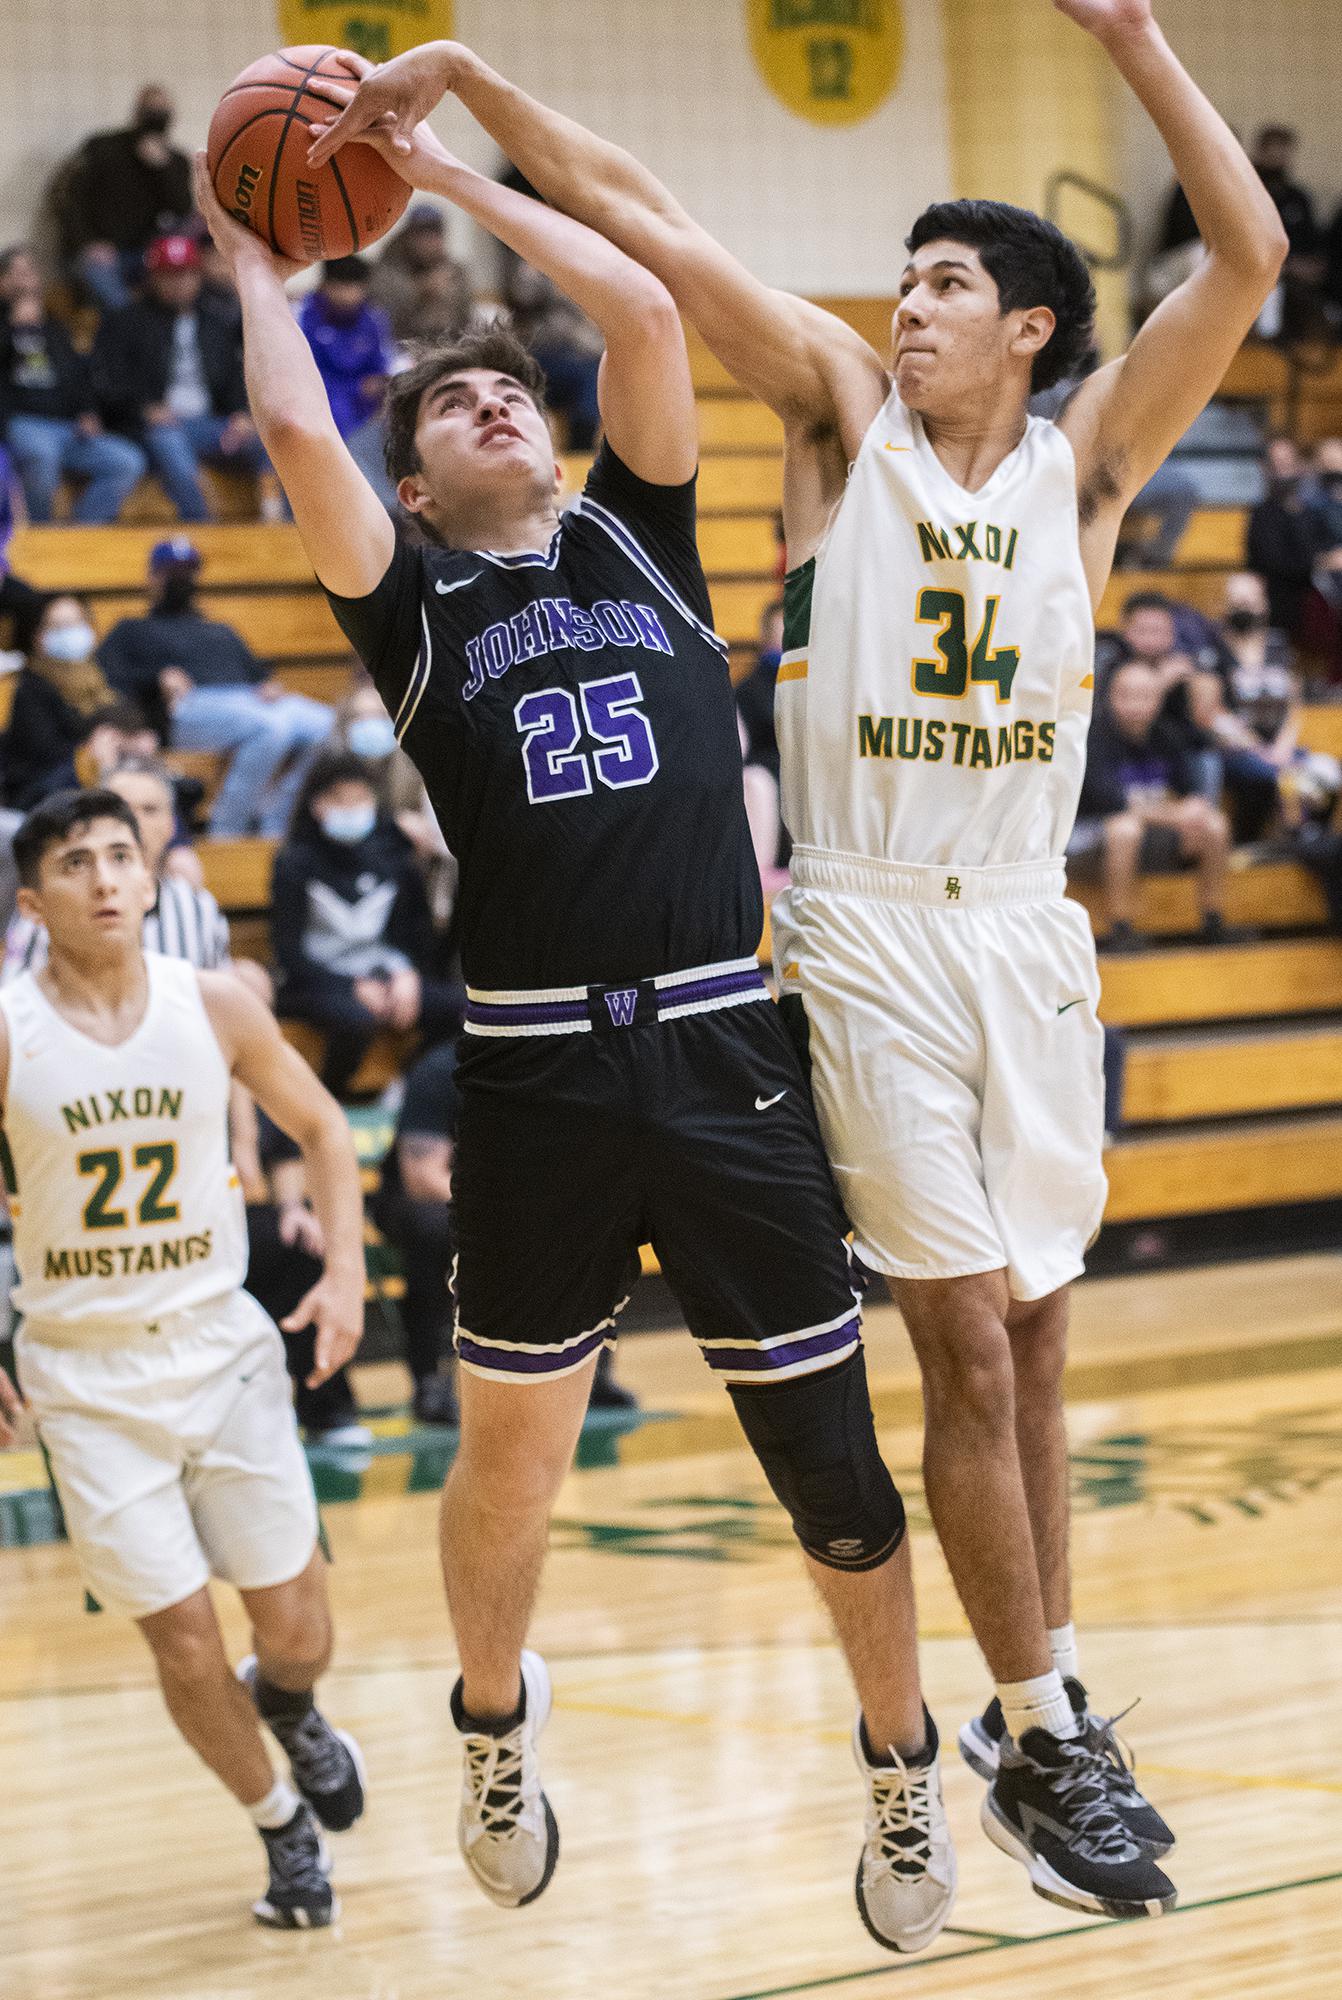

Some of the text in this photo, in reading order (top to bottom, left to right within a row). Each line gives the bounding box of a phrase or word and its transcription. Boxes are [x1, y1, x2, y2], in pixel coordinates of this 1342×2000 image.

[462, 598, 674, 701] JOHNSON
[911, 586, 1021, 705] 34
[513, 671, 660, 805] 25
[857, 715, 1056, 769] MUSTANGS
[604, 989, 637, 1027] W
[61, 1087, 183, 1134] NIXON
[76, 1140, 181, 1232] 22
